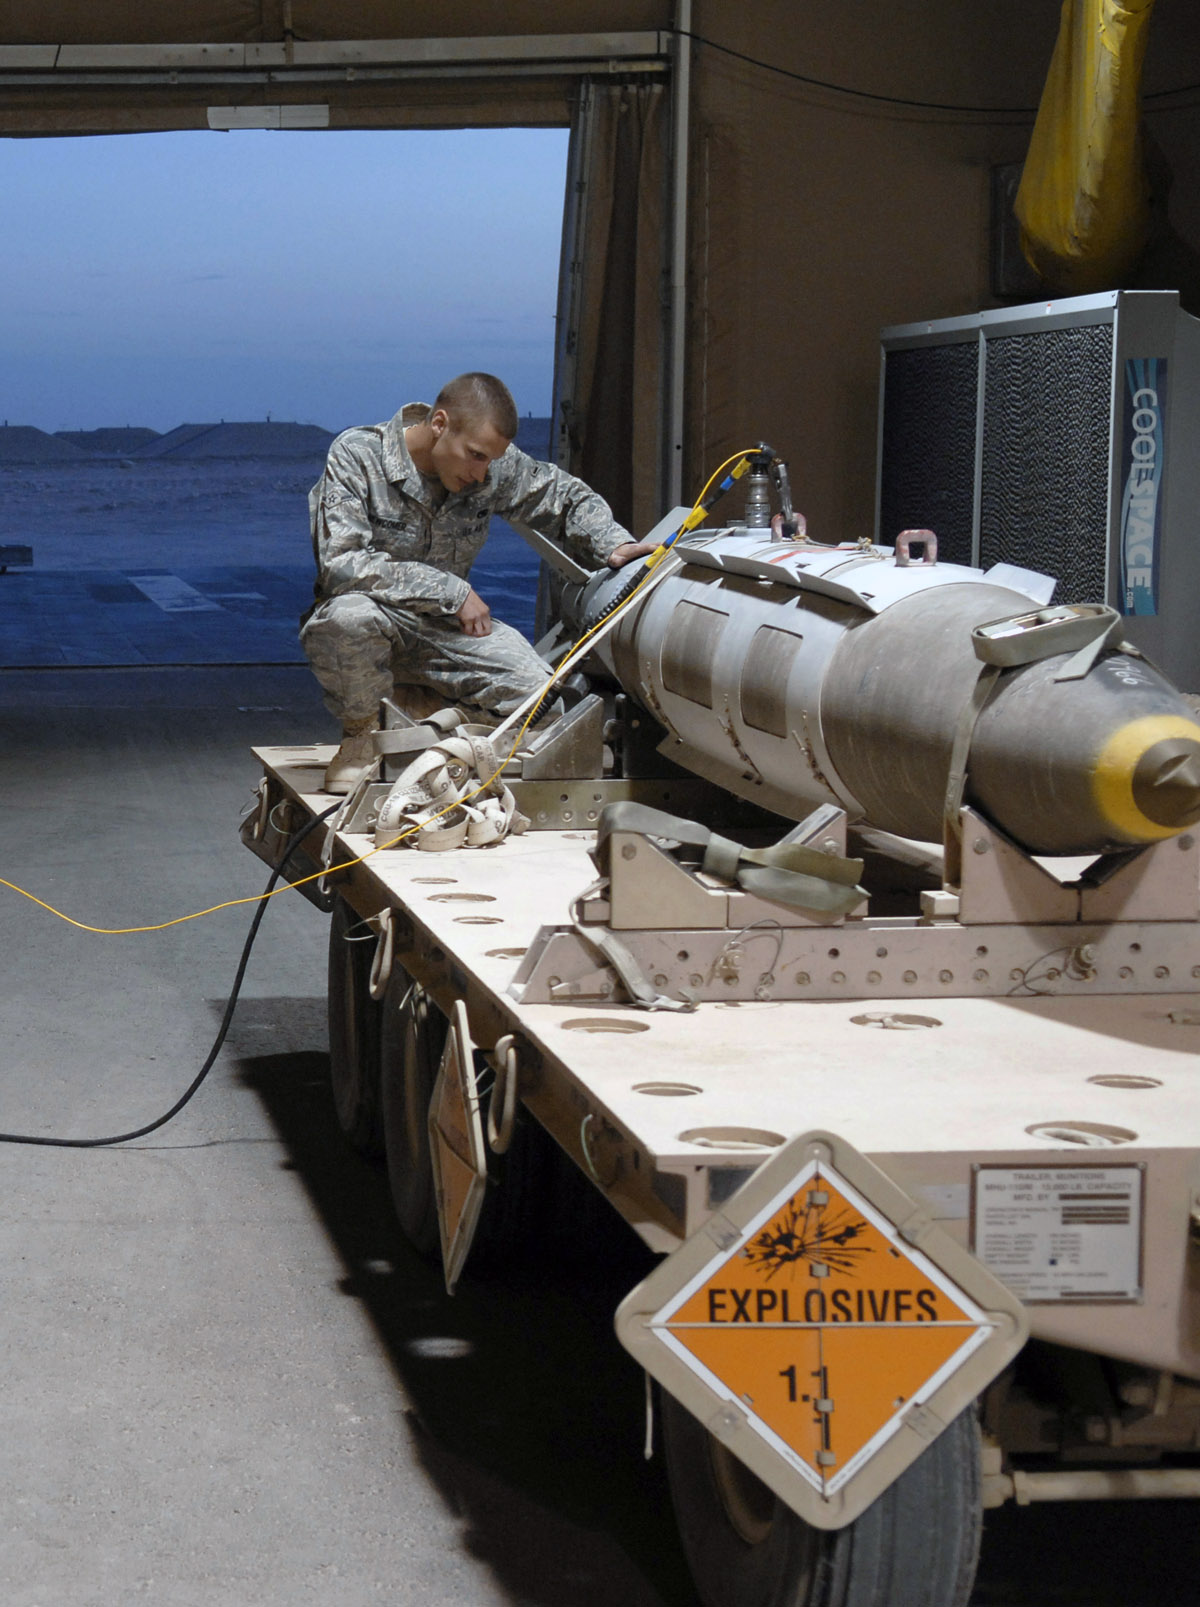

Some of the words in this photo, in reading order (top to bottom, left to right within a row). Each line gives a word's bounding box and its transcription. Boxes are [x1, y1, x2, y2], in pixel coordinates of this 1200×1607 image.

[1127, 388, 1158, 588] COOLSPACE
[708, 1289, 938, 1323] EXPLOSIVES
[778, 1365, 828, 1402] 1.1
